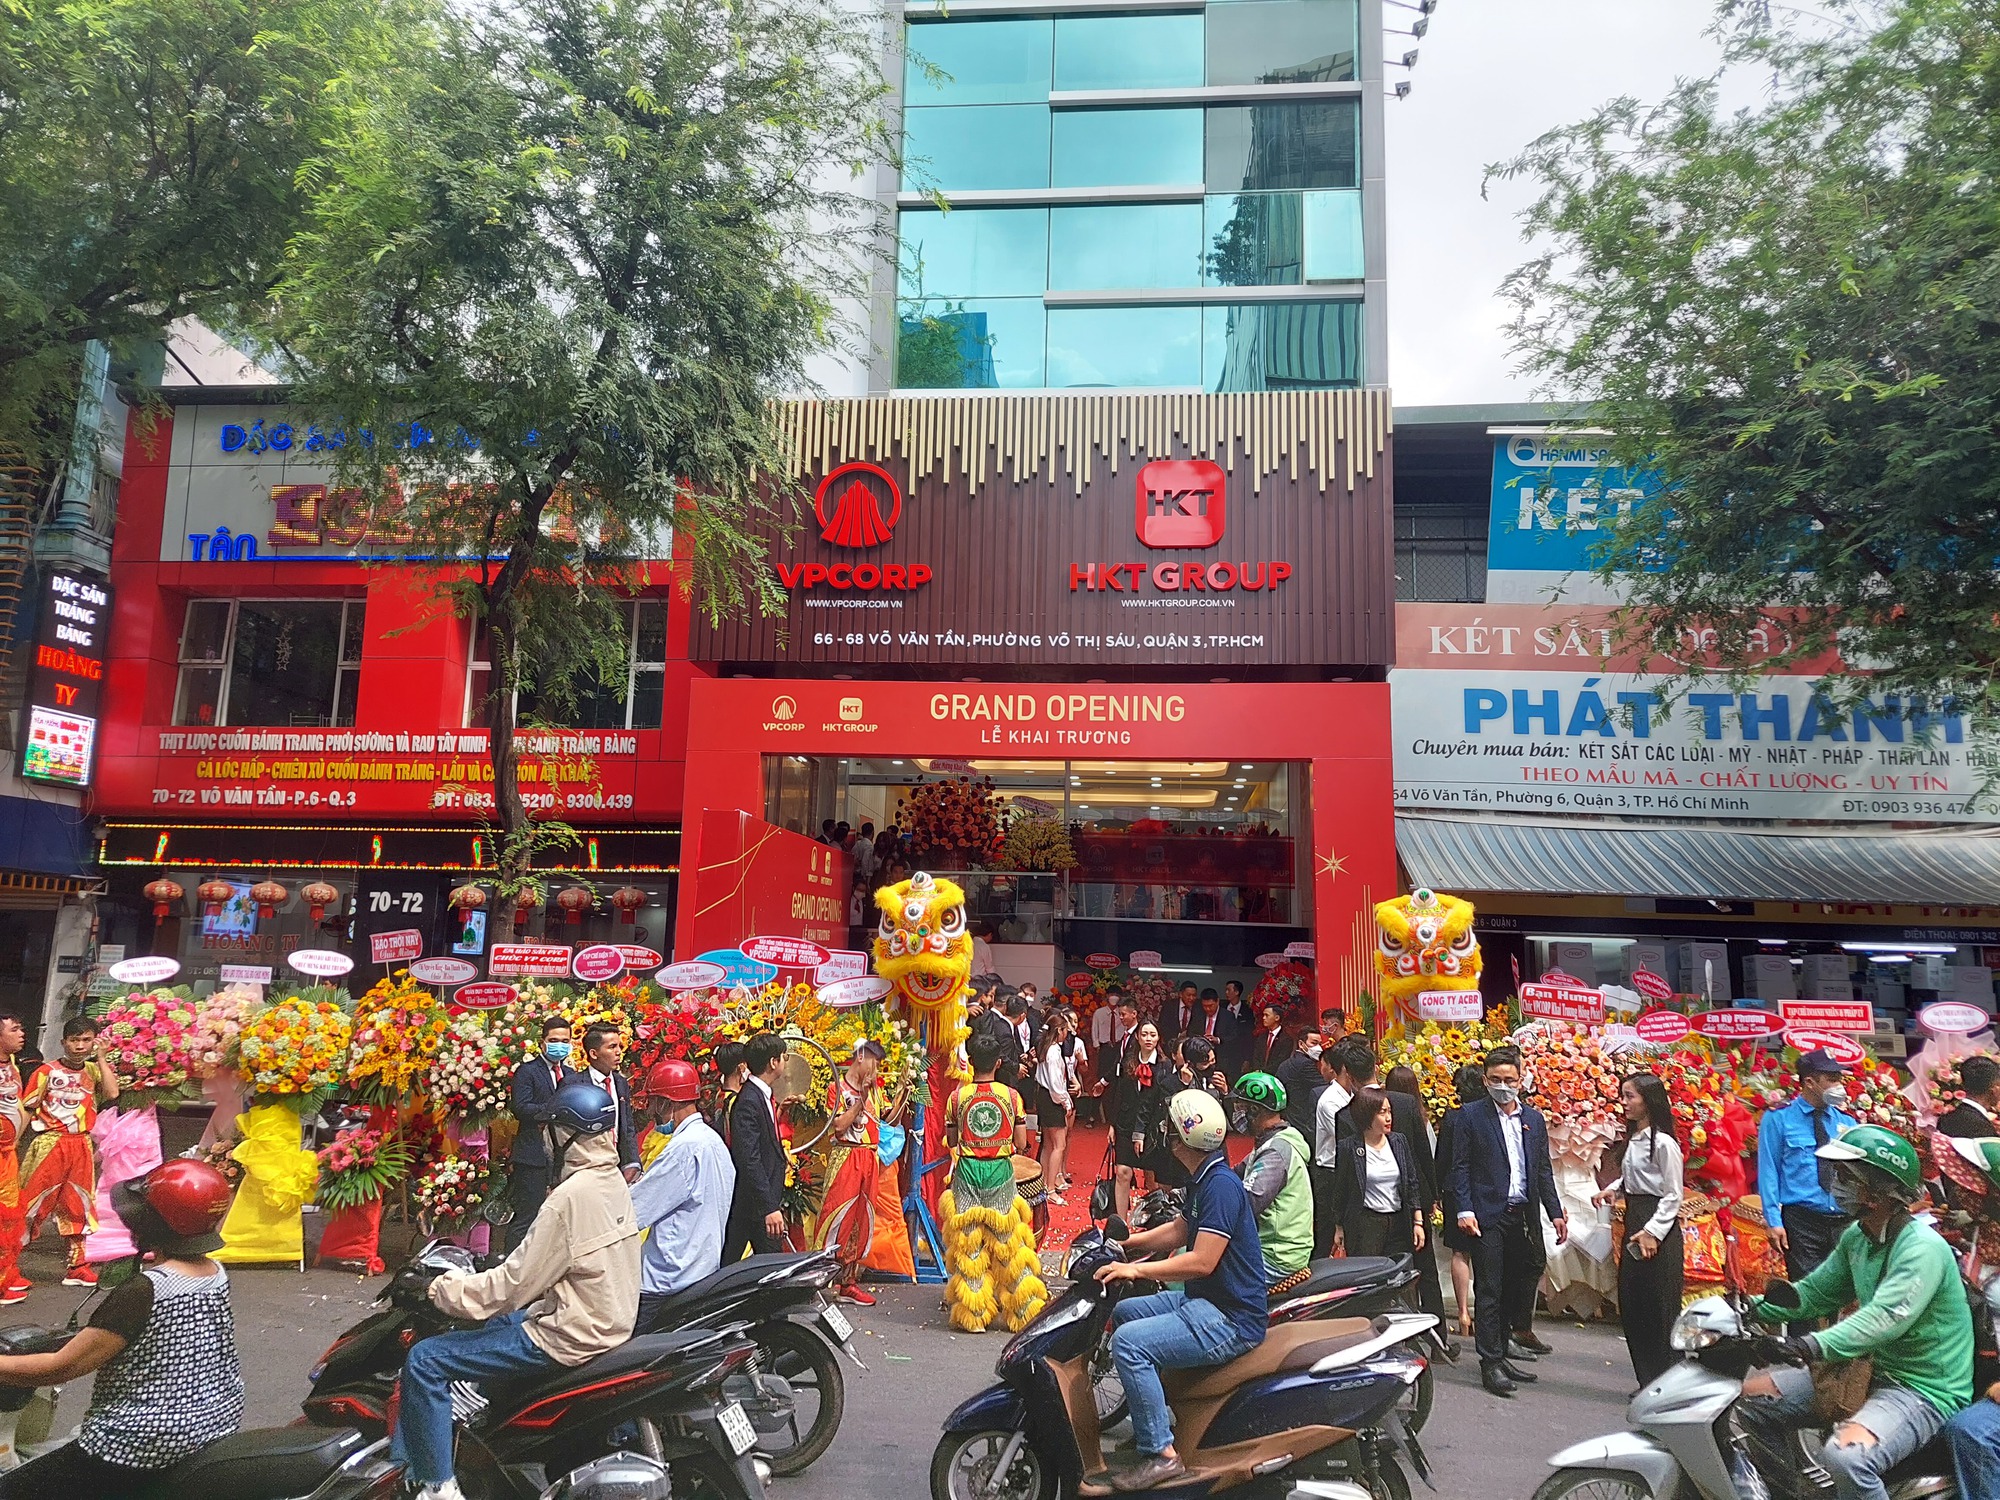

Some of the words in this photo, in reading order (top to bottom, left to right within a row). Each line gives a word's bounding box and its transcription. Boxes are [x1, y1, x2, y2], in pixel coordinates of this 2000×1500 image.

[1147, 489, 1217, 518] HKT
[776, 562, 933, 591] VPCORP
[1069, 561, 1148, 592] HKT
[1152, 561, 1293, 592] GROUP
[52, 576, 80, 597] ĐẶC
[81, 584, 107, 606] SẢN
[1121, 599, 1236, 608] WWW.HKTGROUP.COM.VN
[814, 633, 833, 645] 66
[845, 633, 864, 645] 68
[868, 630, 892, 645] VÕ
[899, 631, 930, 646] VĂN
[1048, 632, 1070, 647] VÕ
[1075, 635, 1101, 651] THỊ
[1143, 632, 1189, 651] QUẬN
[1428, 617, 1521, 656] KÉT
[37, 646, 102, 680] HOÀNG
[55, 683, 80, 706] TY
[842, 705, 860, 713] HKT
[930, 693, 1037, 722] GRAND
[1046, 694, 1186, 723] OPENING
[1463, 678, 1670, 738] PHÁT
[1689, 682, 1964, 744] THÀNH
[762, 722, 805, 731] VPCORP
[822, 723, 843, 732] HKT
[843, 723, 879, 733] GROUP
[981, 724, 1002, 744] LỄ
[1009, 729, 1050, 745] KHAI
[1055, 729, 1132, 745] TRƯƠNG
[159, 733, 185, 754] THỊT
[252, 730, 283, 751] BÁNH
[396, 733, 411, 752] VÀ
[412, 736, 435, 752] RAU
[437, 732, 458, 752] TÂY
[458, 736, 487, 753] NINH
[1412, 739, 1478, 759] Chuyên
[1483, 744, 1524, 756] mua
[1529, 742, 1569, 758] bán:
[1579, 742, 1605, 759] KÉT
[1611, 740, 1639, 760] SẮT
[1645, 743, 1675, 761] CÁC
[1730, 745, 1751, 763] MỸ
[1768, 746, 1807, 767] NHẬT
[1823, 746, 1863, 765] PHÁP
[197, 757, 213, 778] CÁ
[215, 756, 238, 778] LÓC
[240, 755, 264, 779] HẤP
[271, 758, 306, 779] CHIÊN
[326, 756, 359, 780] CUỐN
[360, 757, 393, 780] BÁNH
[395, 759, 434, 781] TRÁNG
[467, 761, 481, 782] VÀ
[1520, 766, 1579, 782] THEO
[1586, 763, 1635, 784] MẪU
[1643, 767, 1679, 786] MÃ
[1700, 766, 1760, 788] CHẤT
[1769, 773, 1848, 792] LƯỢNG
[1871, 775, 1901, 791] UY
[1908, 772, 1948, 791] TÍN
[201, 786, 220, 804] VÕ
[224, 786, 253, 805] VĂN
[256, 784, 286, 805] TẦN
[1411, 789, 1429, 801] Võ
[1433, 789, 1459, 801] Văn
[1462, 788, 1492, 803] Tần,
[1496, 789, 1553, 806] Phường
[1557, 793, 1569, 806] 6,
[1573, 793, 1613, 809] Quận
[1618, 795, 1630, 808] 3,
[1633, 796, 1654, 808] TP.
[1658, 794, 1678, 808] Hồ
[1683, 795, 1707, 809] Chí
[1711, 797, 1749, 810] Minh
[1843, 800, 1868, 813] ĐT:
[1872, 802, 1909, 813] 0903
[1914, 802, 1942, 814] 936
[792, 892, 816, 920] GRAND
[816, 896, 842, 922] OPENING
[202, 929, 274, 951] HOÀNG
[282, 934, 300, 951] TY
[749, 949, 777, 959] VPCORP
[782, 952, 797, 963] HKT
[798, 955, 823, 965] GROUP
[1422, 994, 1445, 1006] CÔNG
[1447, 996, 1456, 1005] TY
[1876, 1146, 1909, 1170] Grab
